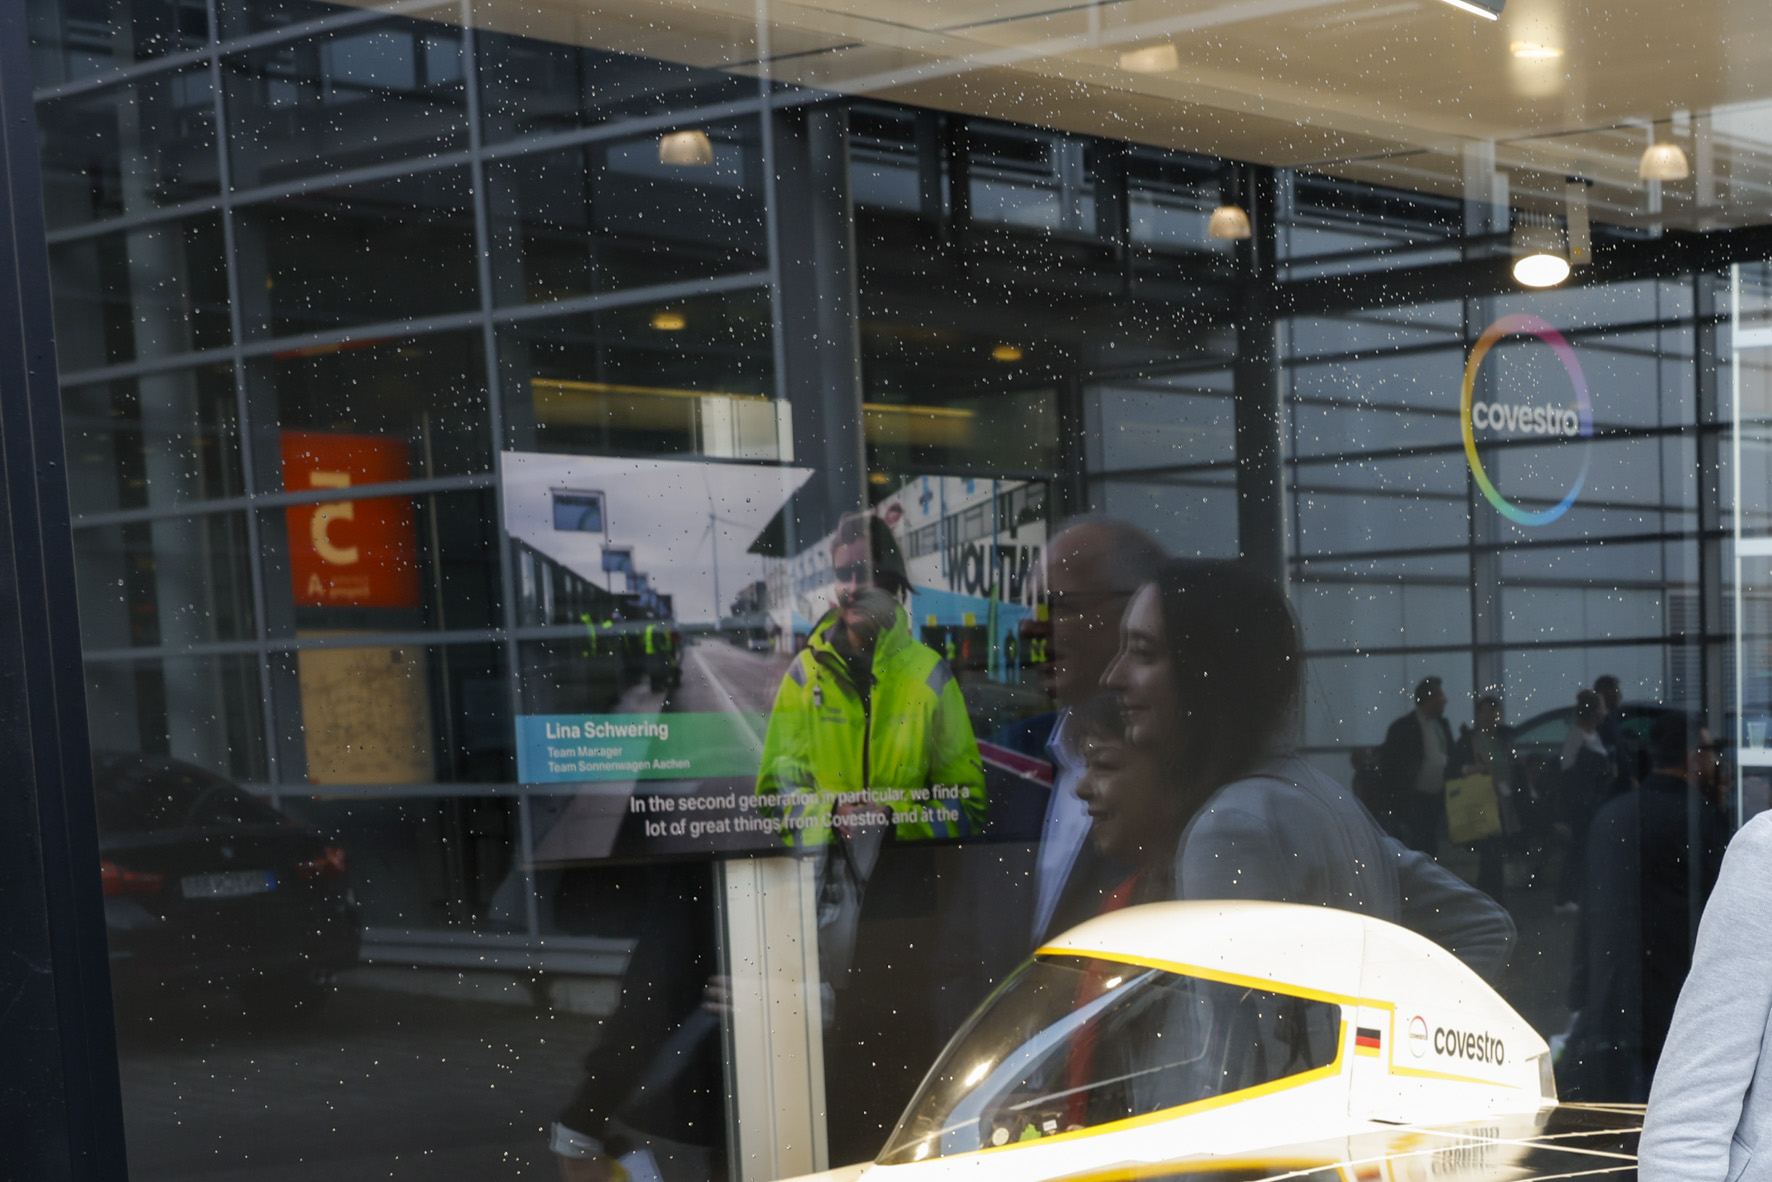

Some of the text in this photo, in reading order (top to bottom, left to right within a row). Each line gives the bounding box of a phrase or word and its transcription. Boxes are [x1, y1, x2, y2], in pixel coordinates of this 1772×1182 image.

[1472, 401, 1580, 437] covestro
[546, 720, 669, 741] Lina Schwering
[548, 746, 623, 759] Team Manager
[548, 758, 690, 773] Team Sonnenwagen Aachen
[630, 784, 970, 813] In the second generation in particular, we find a
[645, 806, 960, 838] lot of great things from Covestro, and at the
[1434, 1026, 1505, 1066] covestro
